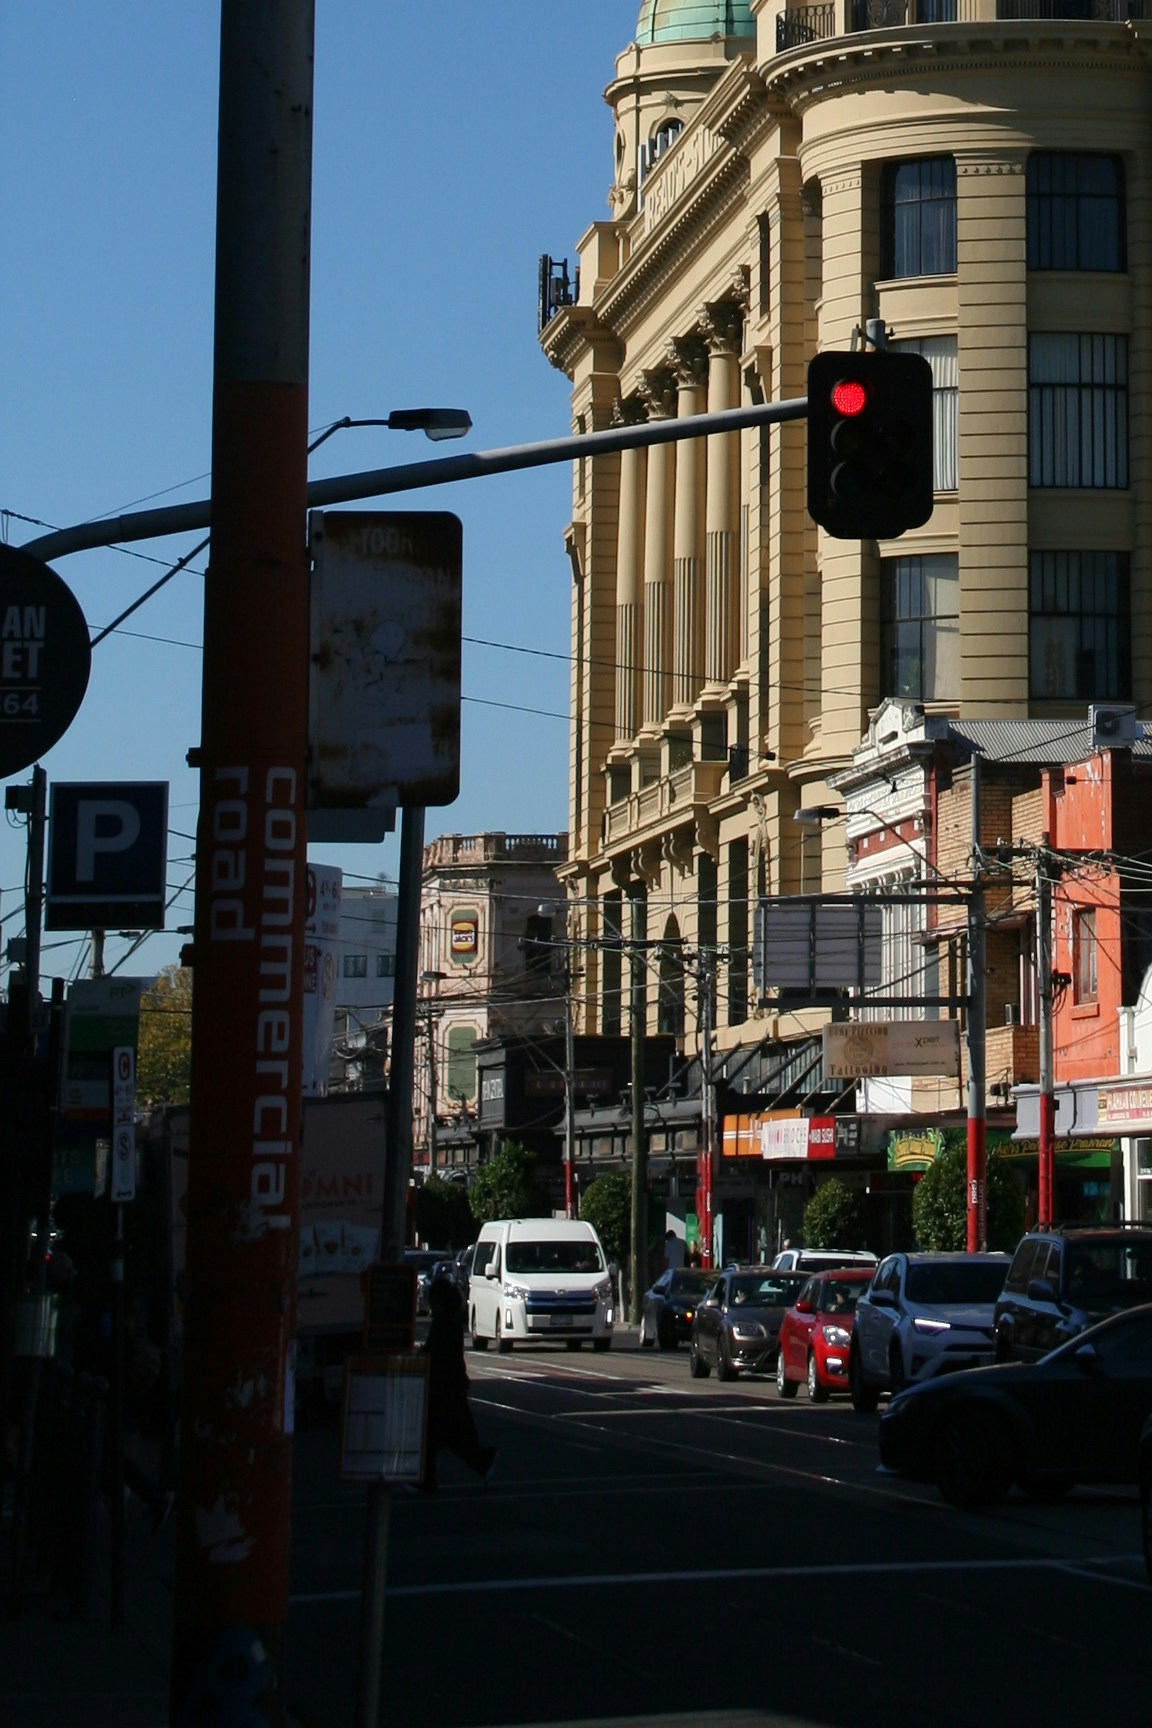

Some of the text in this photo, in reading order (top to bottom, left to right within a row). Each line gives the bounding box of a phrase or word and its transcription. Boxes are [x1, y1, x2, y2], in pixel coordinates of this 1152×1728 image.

[0, 693, 39, 715] 64
[75, 800, 141, 882] P
[210, 765, 256, 942] road
[250, 766, 298, 1229] commercial
